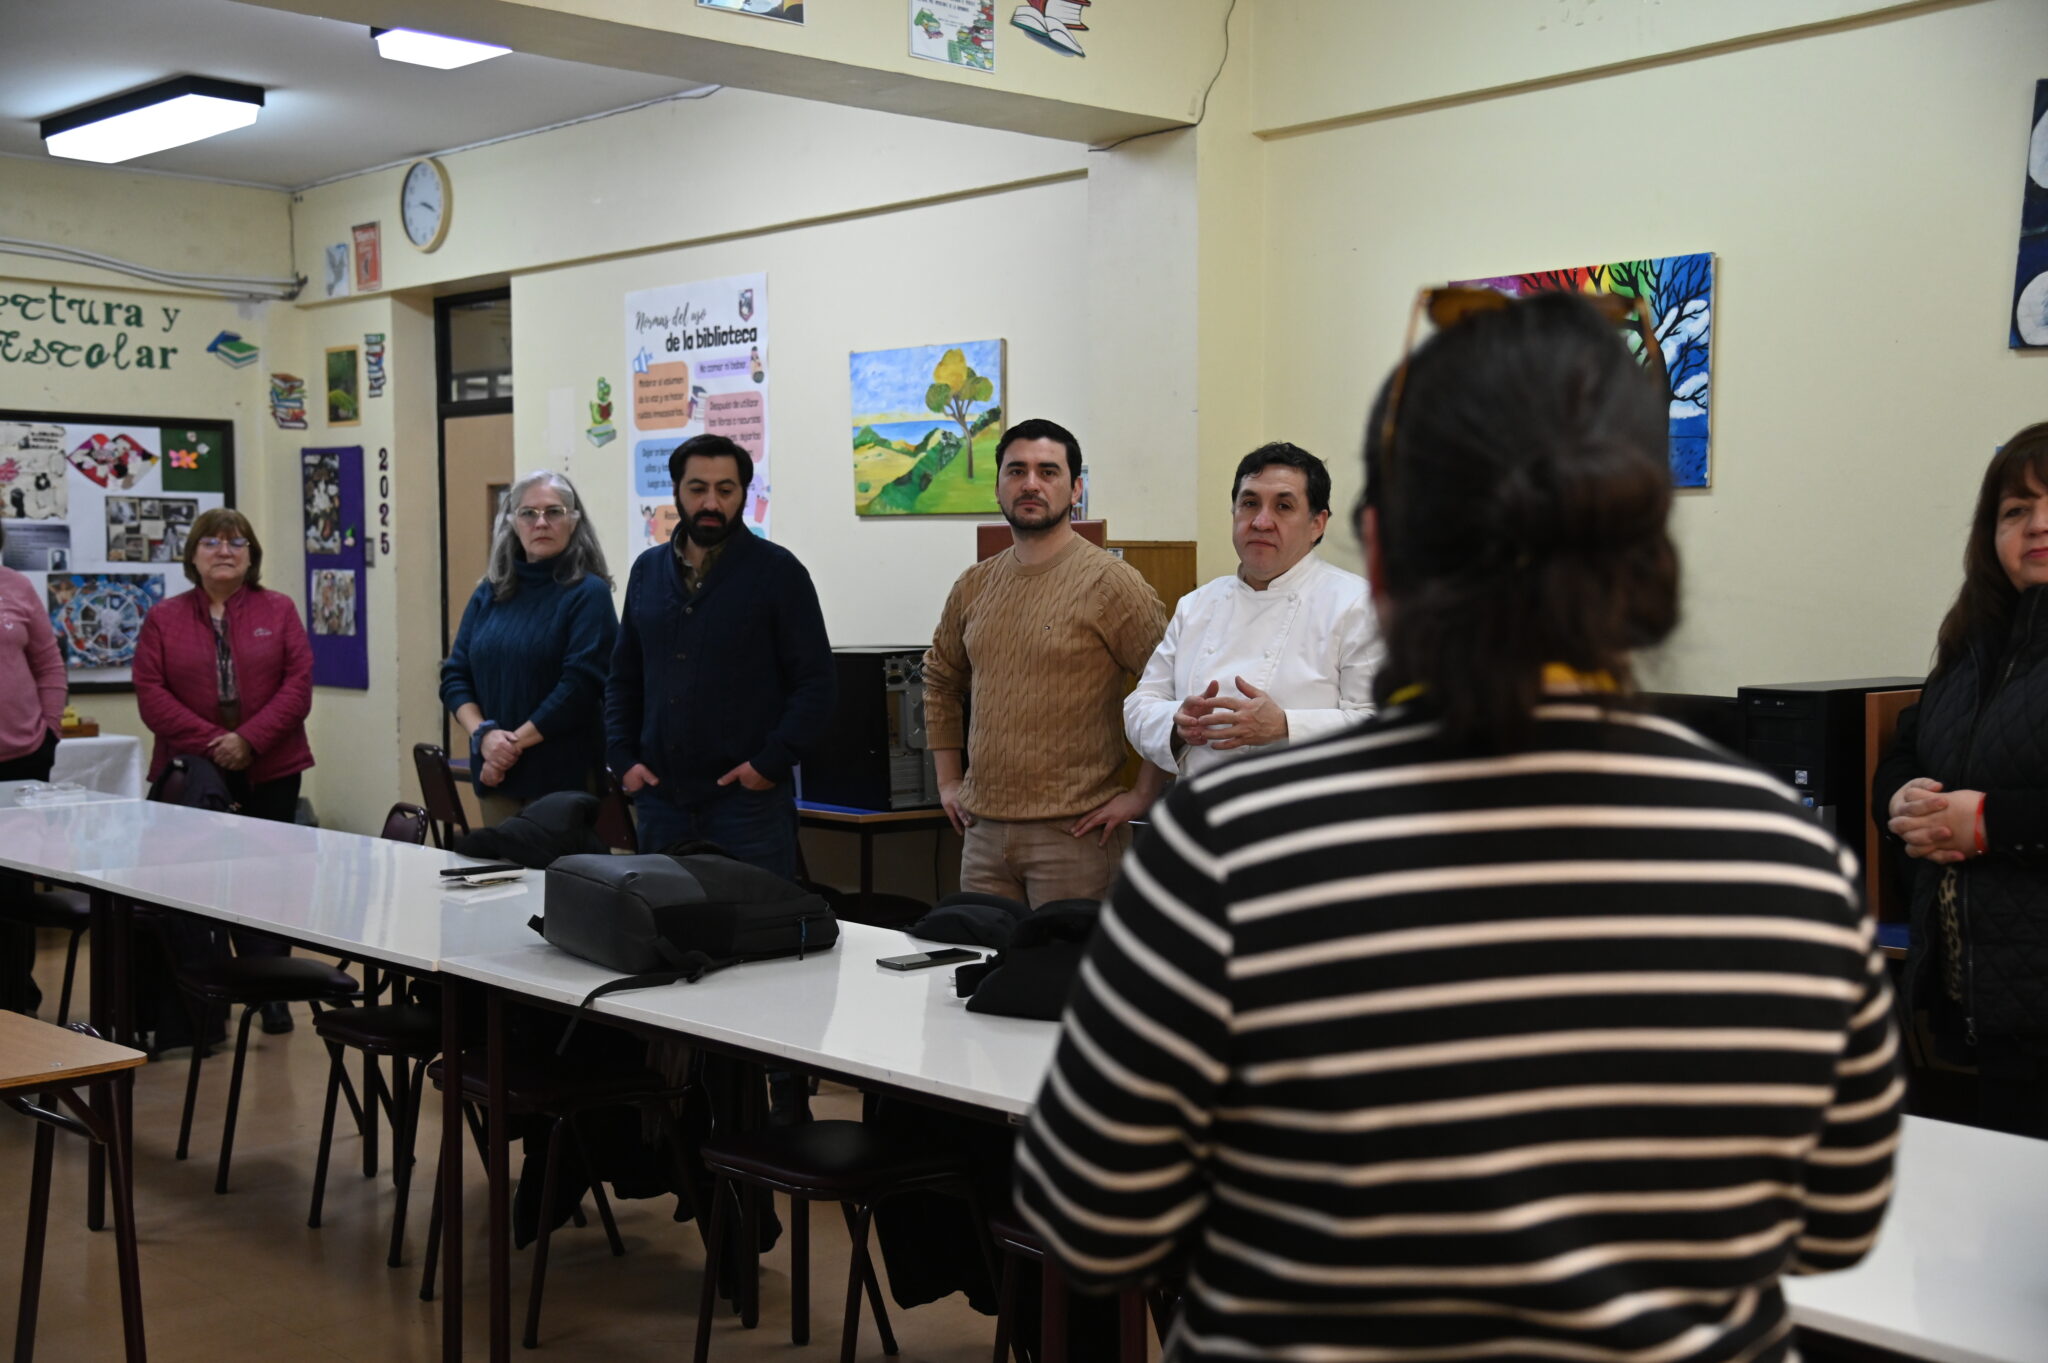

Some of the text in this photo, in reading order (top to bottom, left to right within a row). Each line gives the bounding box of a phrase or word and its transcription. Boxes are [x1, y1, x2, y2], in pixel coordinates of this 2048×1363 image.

[161, 306, 181, 333] y
[671, 302, 690, 327] del
[665, 325, 758, 352] de la biblioteca
[378, 448, 390, 555] 2025
